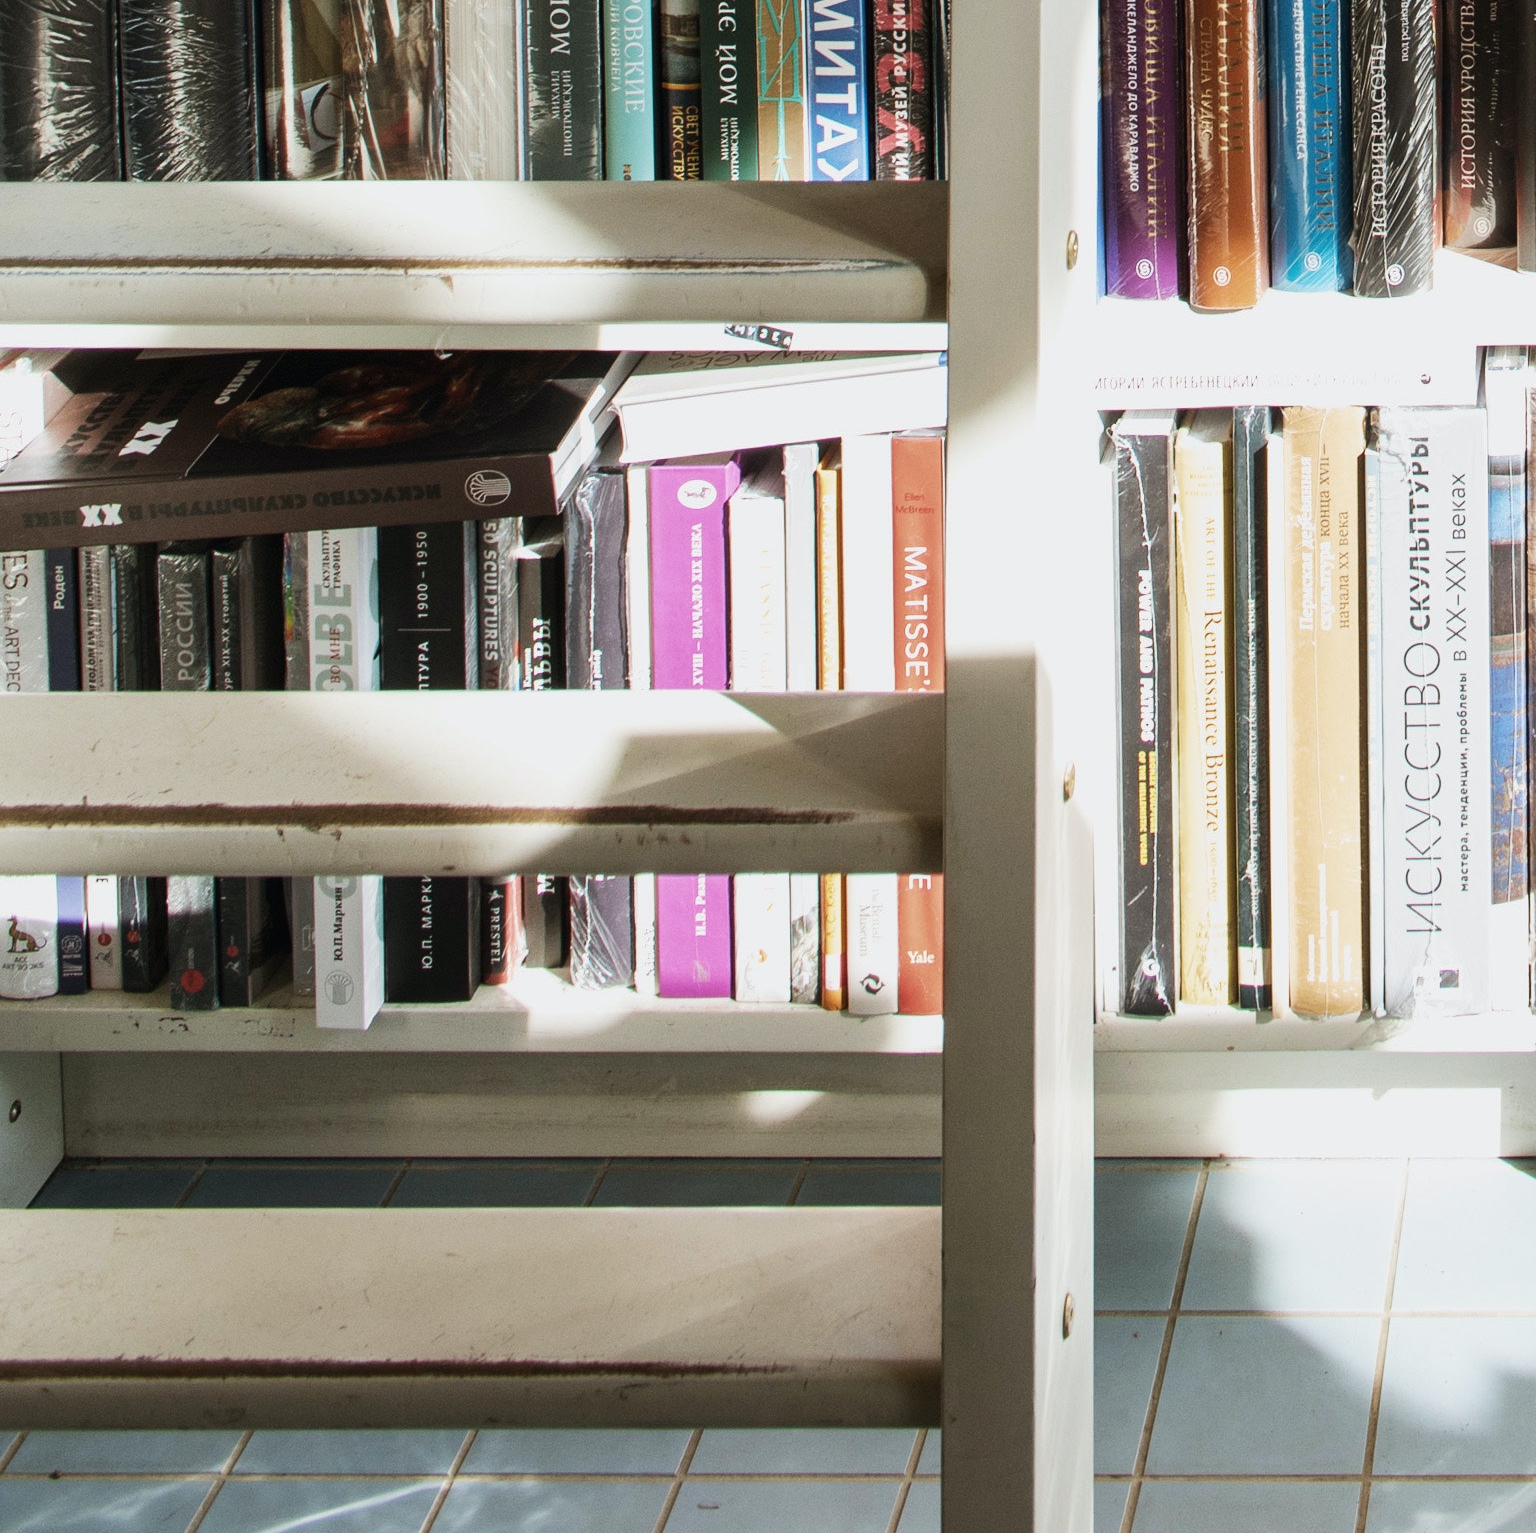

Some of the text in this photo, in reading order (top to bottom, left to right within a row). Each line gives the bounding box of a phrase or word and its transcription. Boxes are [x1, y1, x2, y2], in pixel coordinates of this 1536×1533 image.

[1460, 97, 1477, 190] ИСТОРИЯ
[1403, 436, 1442, 934] ИСКУССТВО СКУЛЬПТУРЫ
